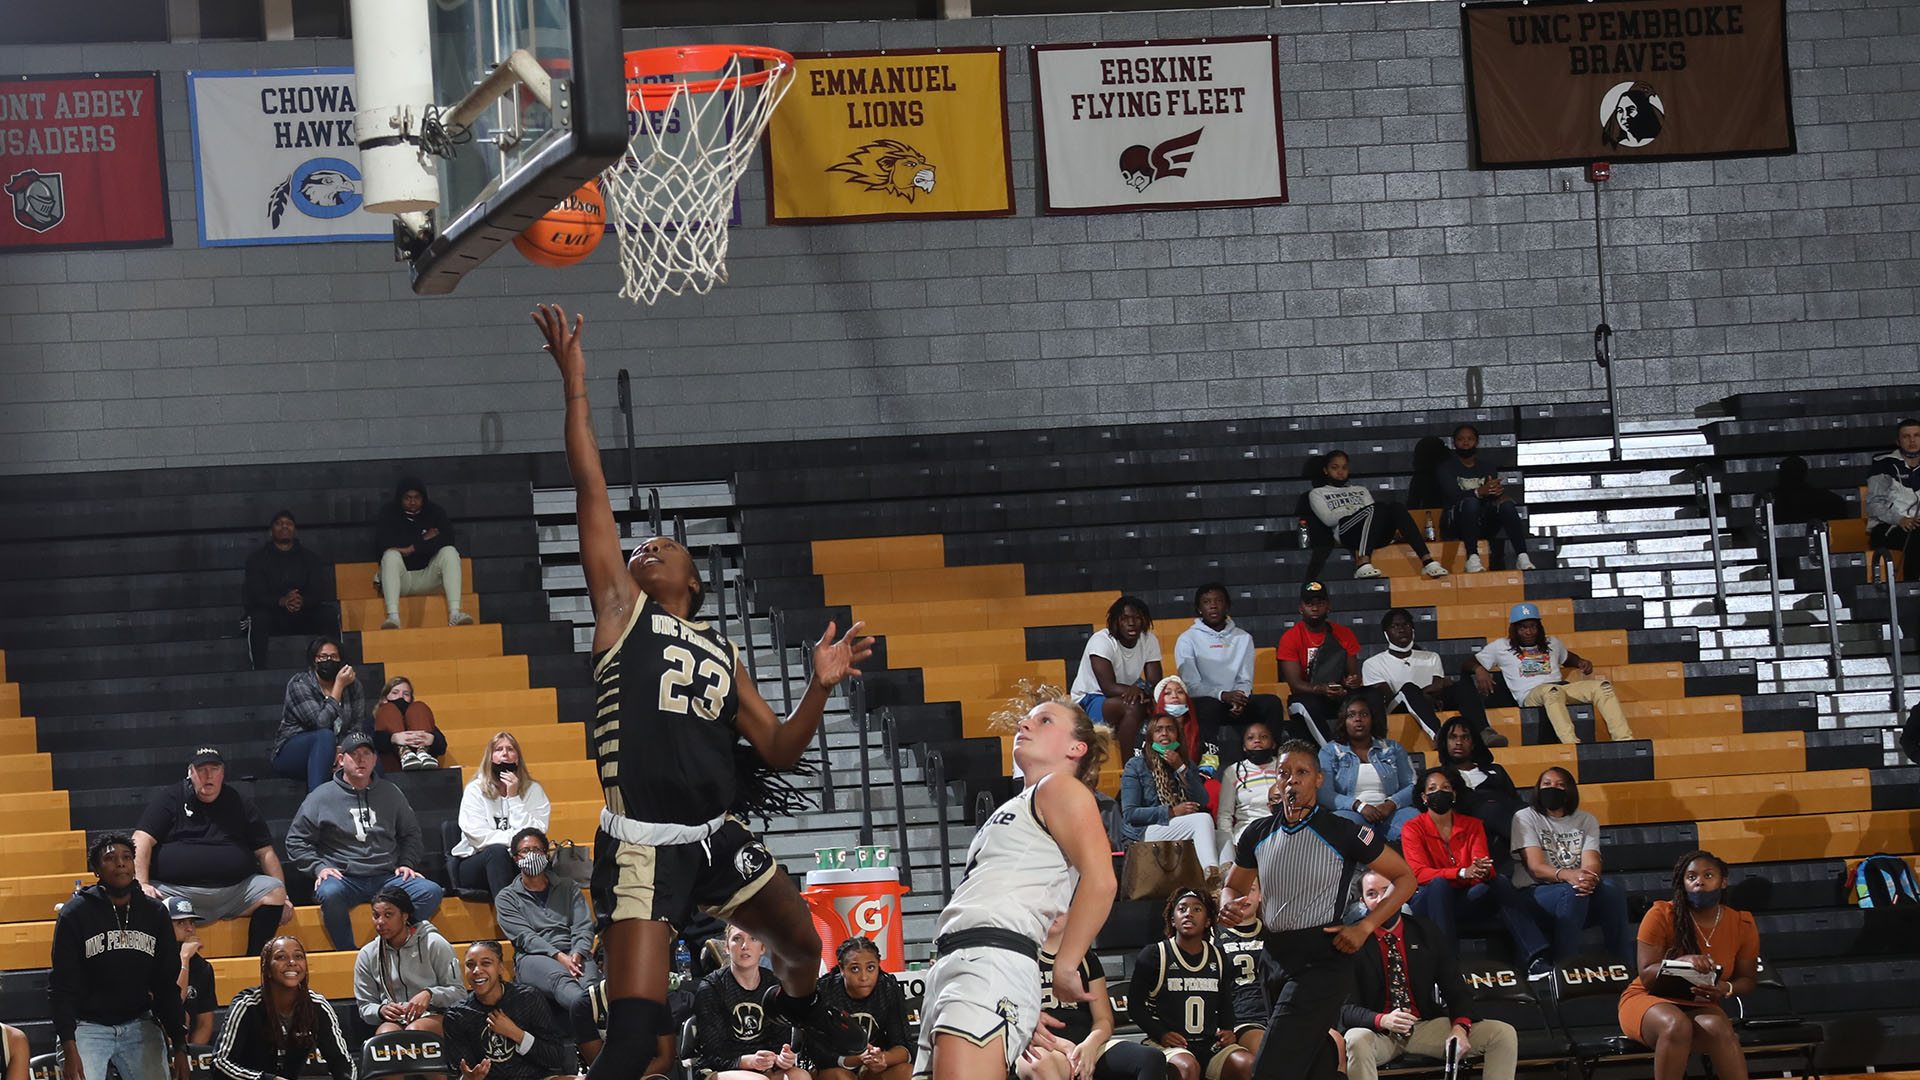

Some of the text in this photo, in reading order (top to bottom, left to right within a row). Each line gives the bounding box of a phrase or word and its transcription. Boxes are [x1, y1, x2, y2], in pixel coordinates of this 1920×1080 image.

[1508, 5, 1744, 45] UNC PEMBROKE
[1100, 56, 1213, 85] ERSKINE
[1569, 42, 1687, 75] BRAVES
[809, 65, 956, 96] EMMANUEL
[54, 90, 143, 119] ABBEY
[261, 86, 356, 114] CHOWA
[847, 100, 924, 129] LIONS
[1071, 87, 1246, 120] FLYING FLEET
[274, 120, 356, 148] HAWK
[551, 194, 600, 217] ilson
[651, 614, 679, 637] UNC
[658, 644, 731, 721] 23
[349, 807, 377, 842] P
[855, 900, 883, 932] G
[85, 930, 157, 958] UNC PEMBROKE
[1233, 954, 1256, 986] 3
[1463, 970, 1517, 989] NC
[1562, 965, 1629, 985] UNC
[1184, 996, 1205, 1034] 0
[370, 1041, 442, 1062] UNC
